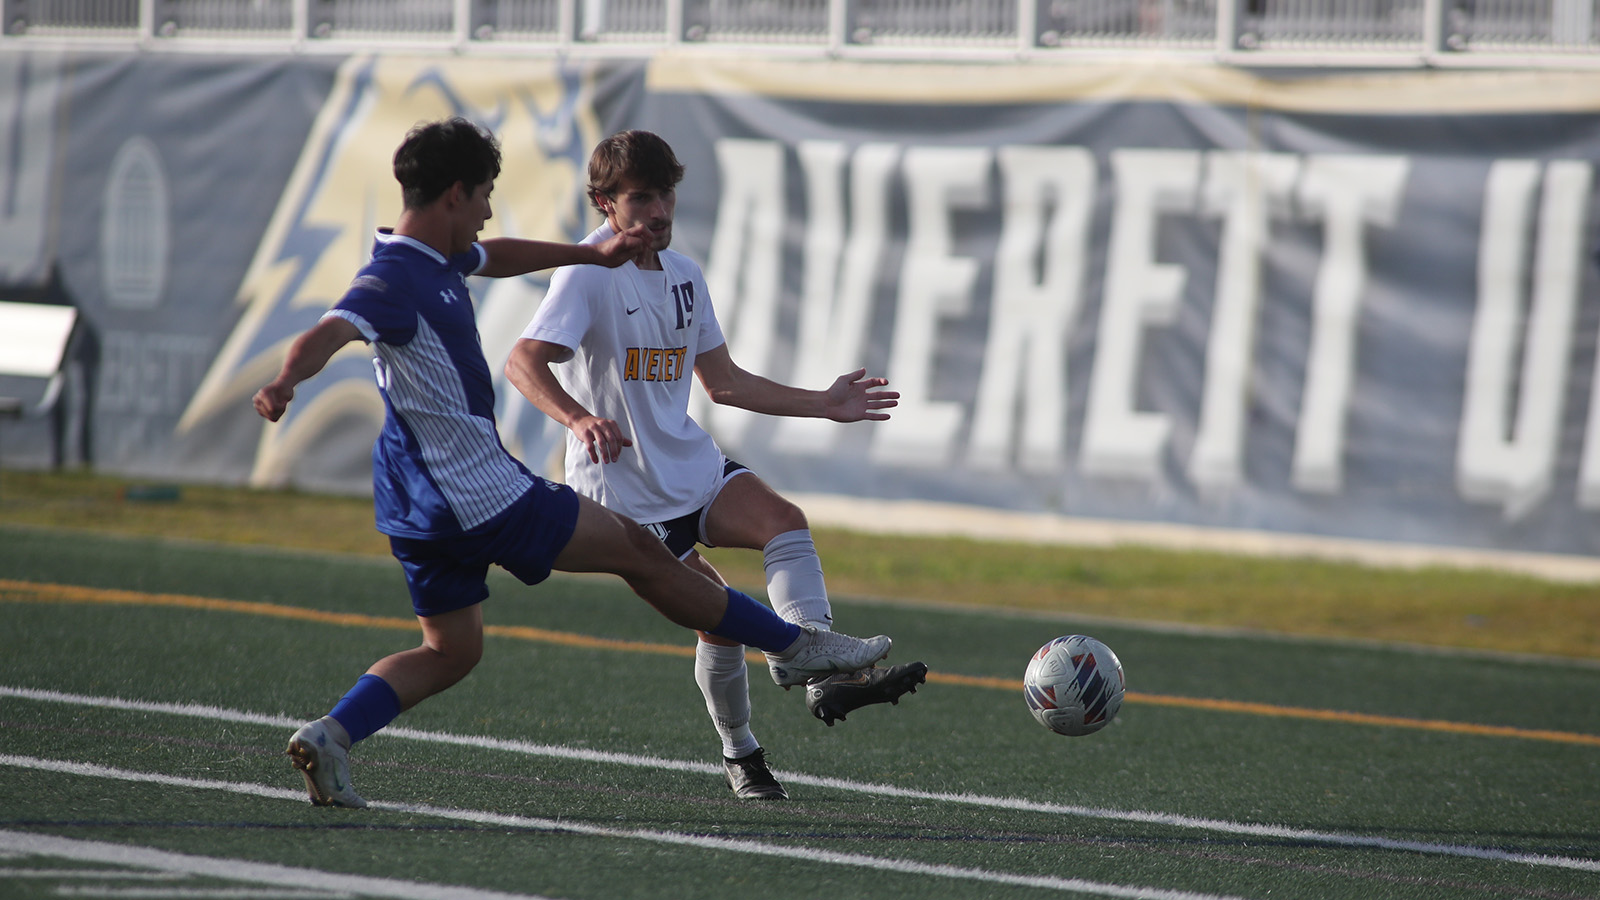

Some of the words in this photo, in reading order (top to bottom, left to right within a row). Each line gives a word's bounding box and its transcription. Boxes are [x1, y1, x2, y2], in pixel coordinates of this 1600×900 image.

[670, 280, 694, 330] 19
[693, 138, 1412, 493] AVERETT
[1455, 158, 1600, 523] U
[623, 345, 687, 382] AVERETT
